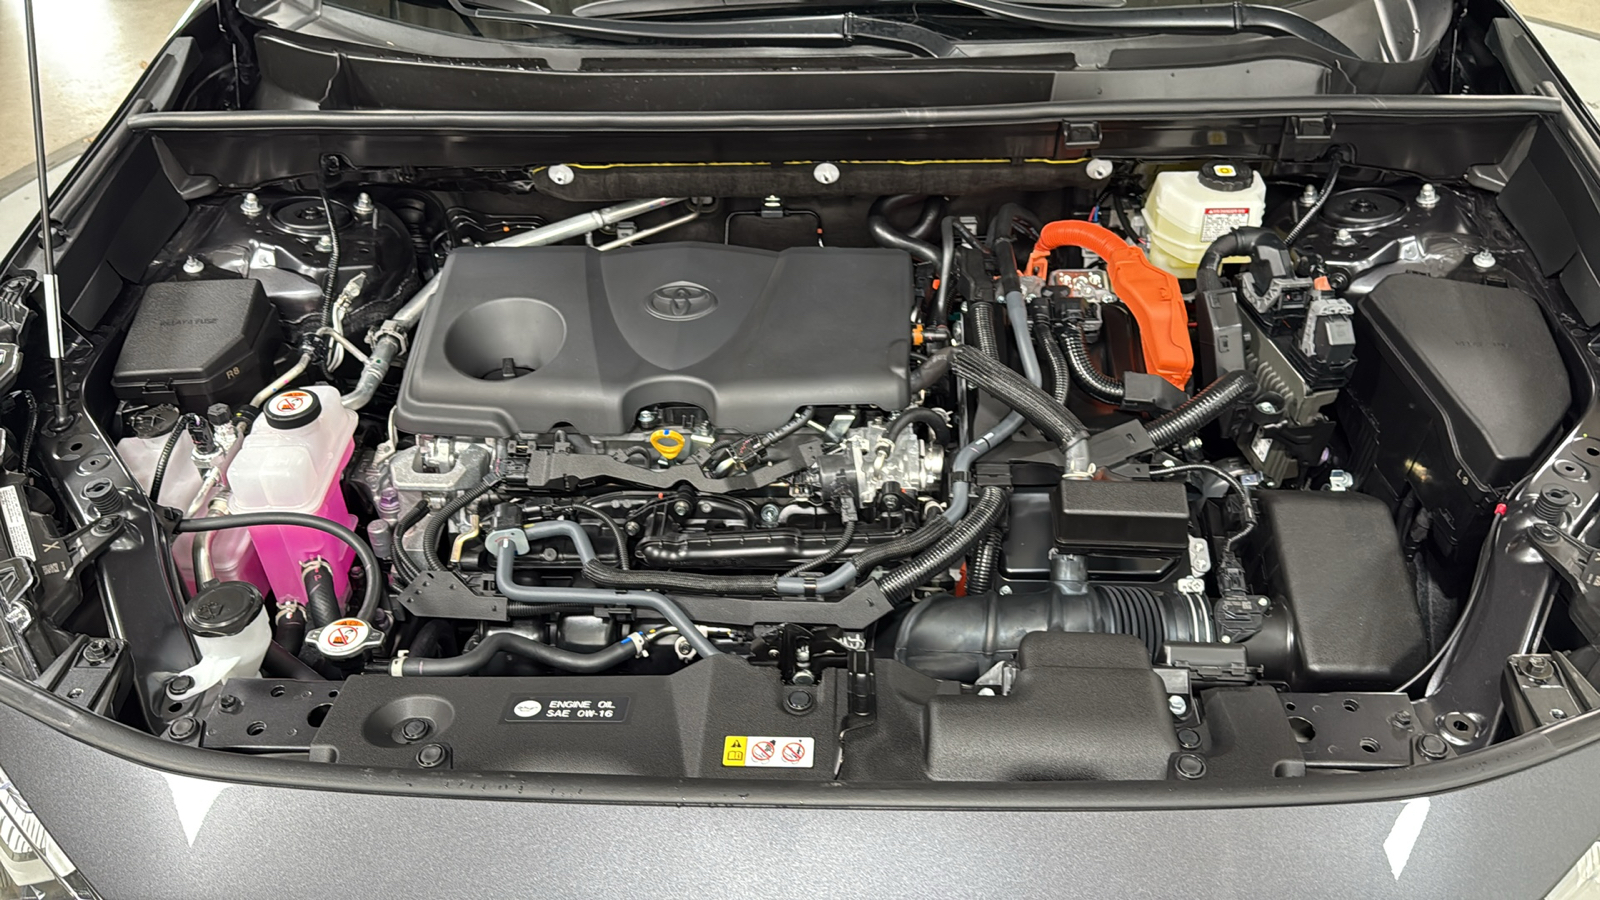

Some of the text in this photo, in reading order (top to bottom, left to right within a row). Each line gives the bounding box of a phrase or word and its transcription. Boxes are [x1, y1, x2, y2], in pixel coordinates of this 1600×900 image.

[225, 366, 240, 380] R8
[548, 700, 616, 709] ENGINE OIL
[545, 709, 614, 718] SAE 0W-16
